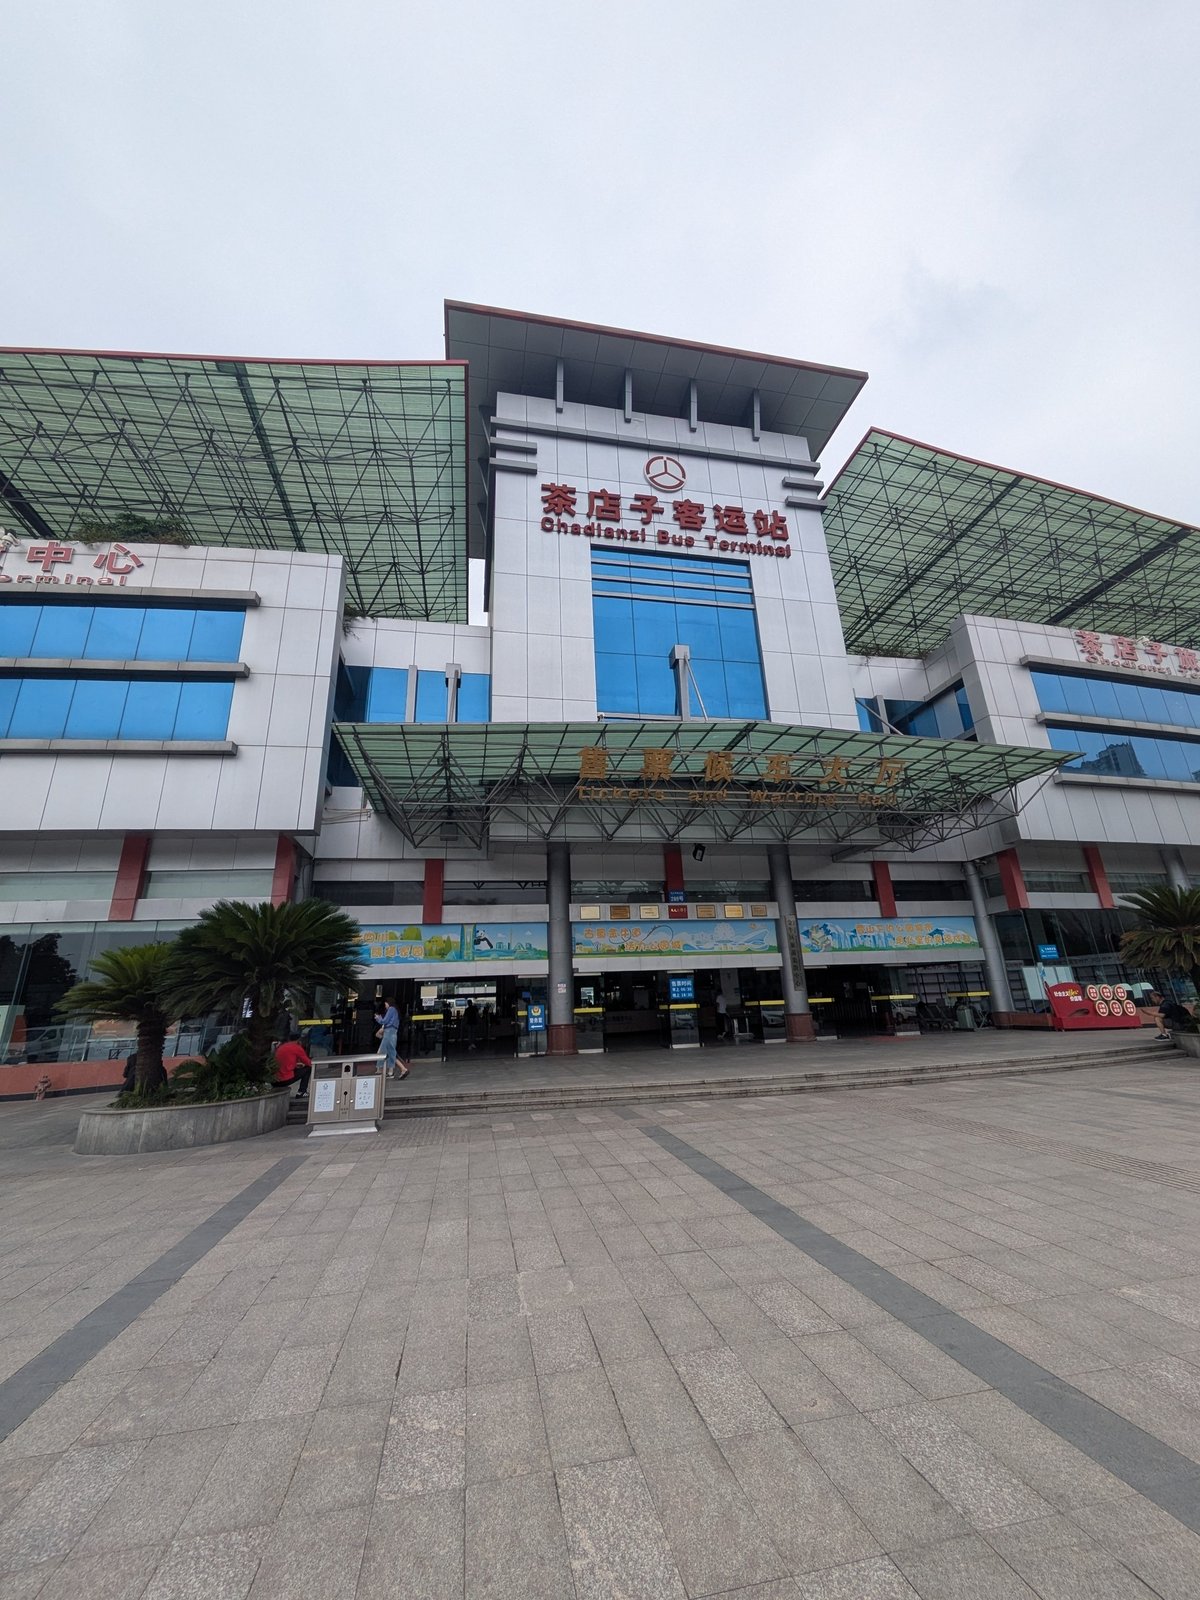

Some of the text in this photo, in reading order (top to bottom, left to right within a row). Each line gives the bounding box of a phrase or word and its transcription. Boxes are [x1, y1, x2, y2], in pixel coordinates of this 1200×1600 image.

[541, 483, 789, 541] 茶店子客运站
[26, 540, 144, 574] 中心
[541, 516, 792, 558] Chadianzi Bus Terminal
[577, 745, 907, 788] 售票候车大厅
